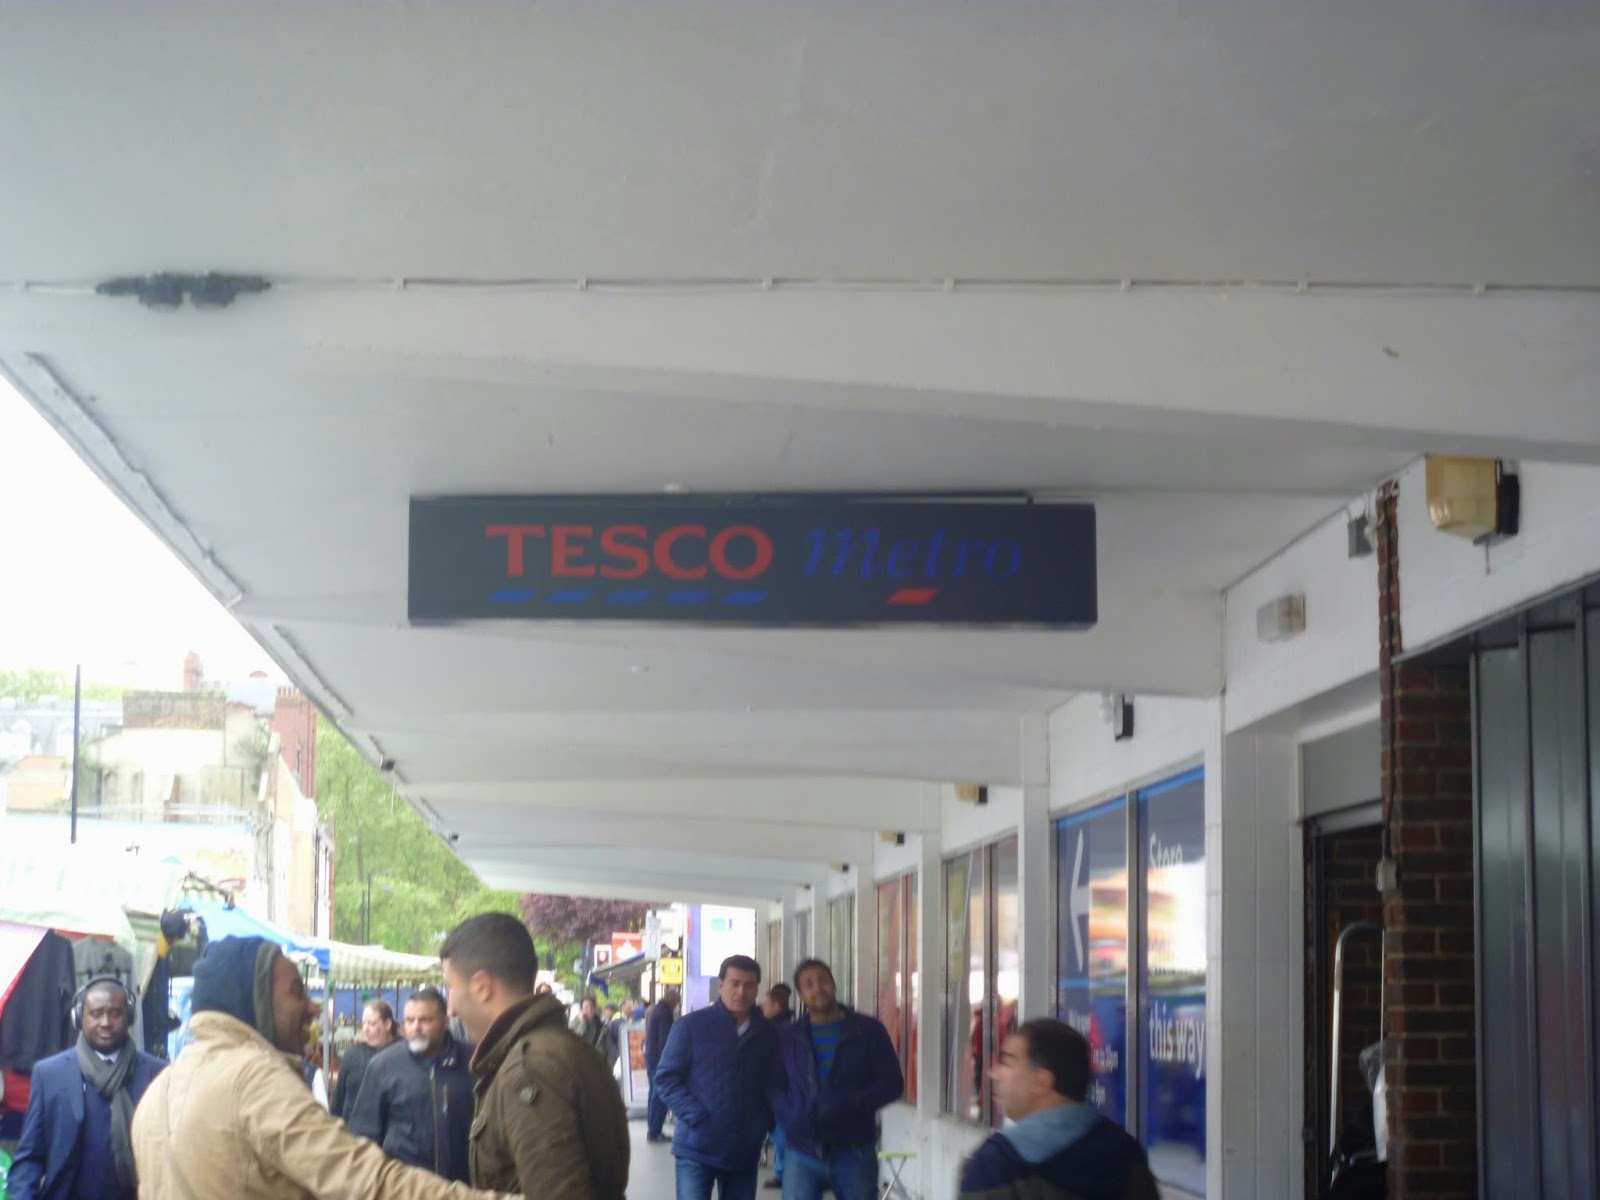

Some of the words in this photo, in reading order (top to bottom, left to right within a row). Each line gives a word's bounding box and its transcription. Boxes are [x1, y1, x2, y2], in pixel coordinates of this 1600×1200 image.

[485, 524, 774, 581] TESCO
[1149, 832, 1183, 873] Store
[1149, 1000, 1173, 1062] this
[1175, 1016, 1205, 1080] way
